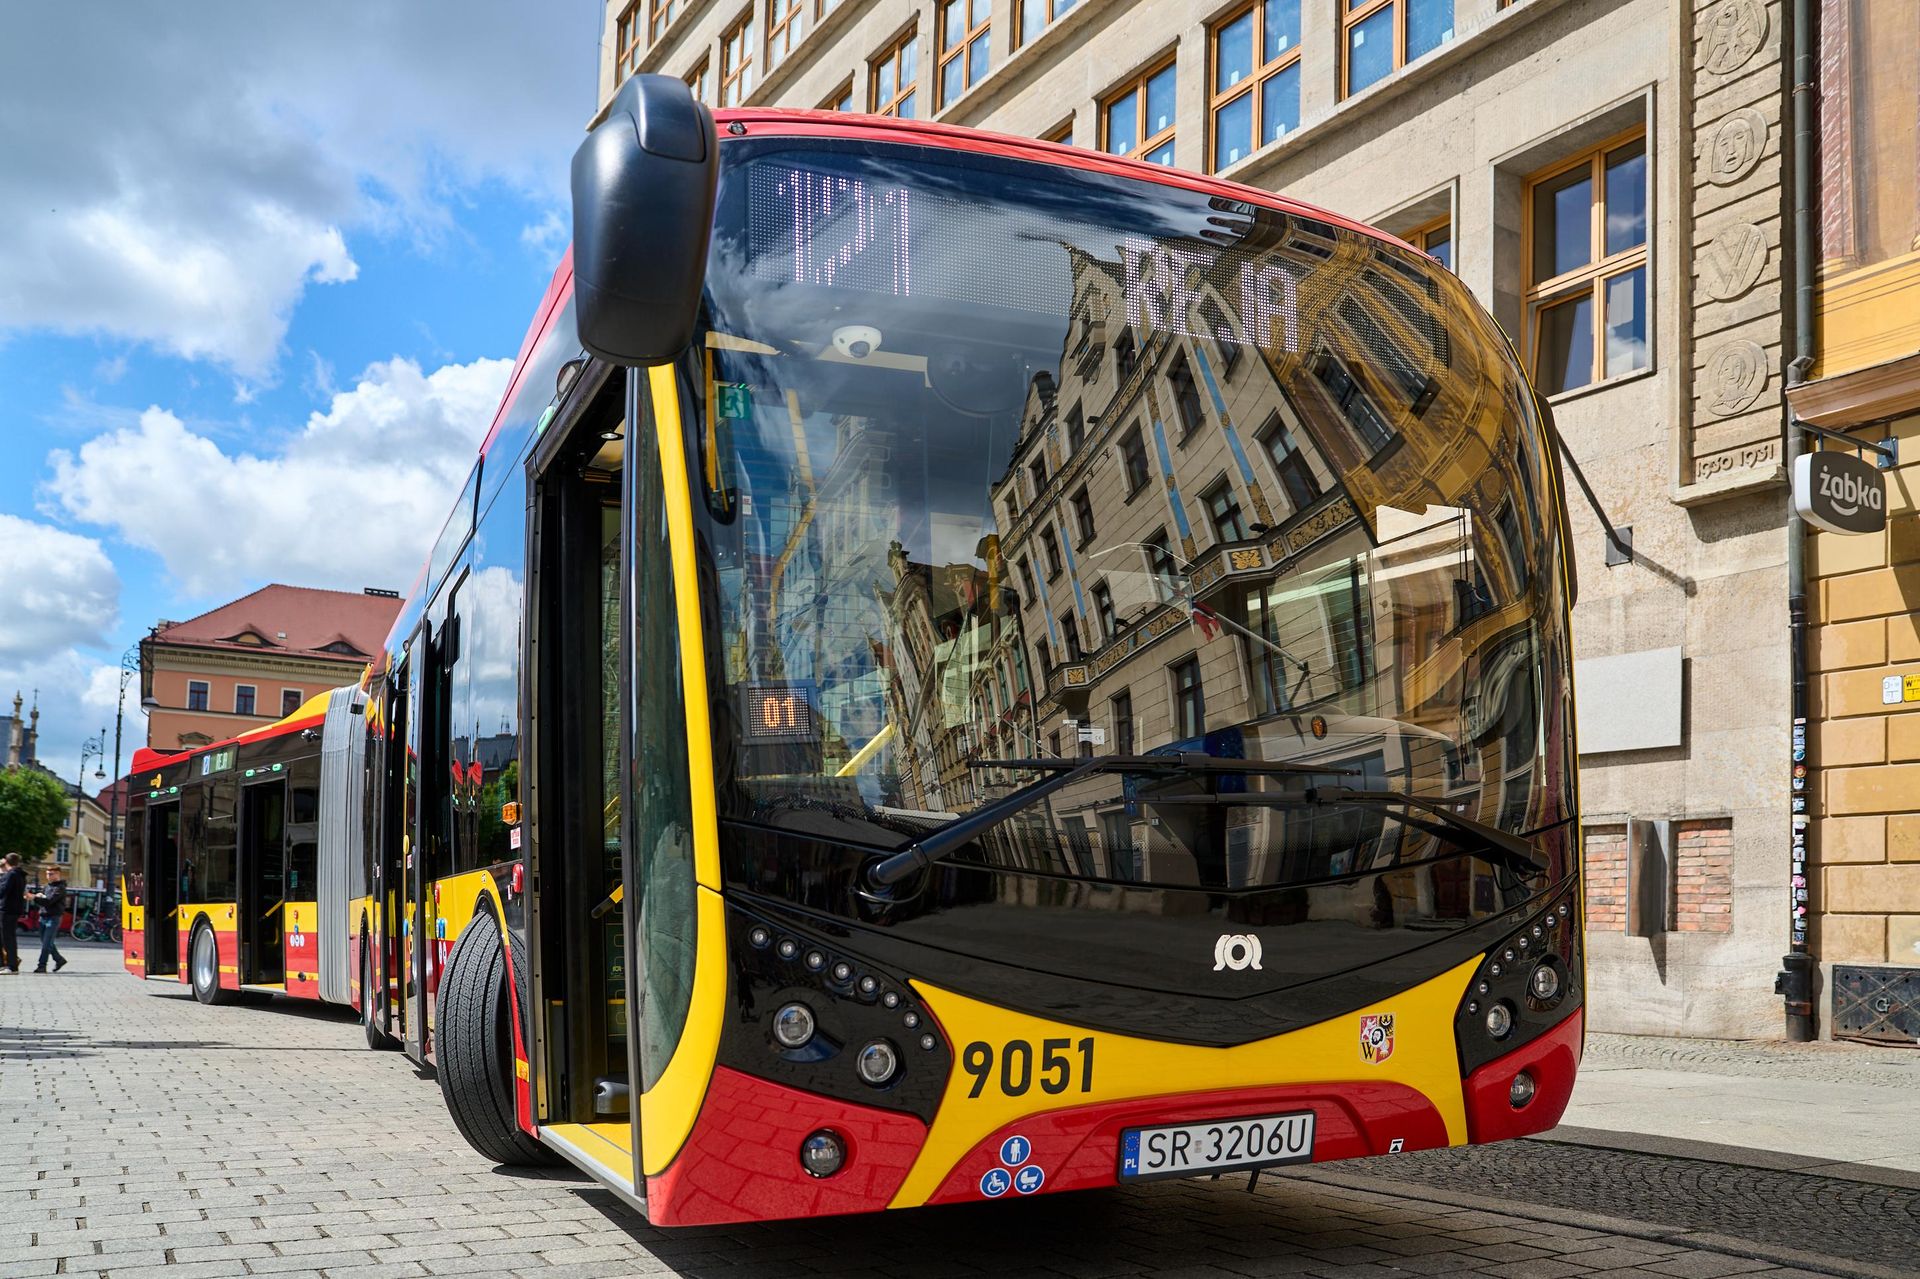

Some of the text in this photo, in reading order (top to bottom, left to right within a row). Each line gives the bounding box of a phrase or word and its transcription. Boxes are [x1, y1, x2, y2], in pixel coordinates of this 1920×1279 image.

[1125, 237, 1298, 352] REJA
[1819, 465, 1882, 510] żabka
[763, 697, 796, 727] 01
[1875, 997, 1890, 1012] G
[962, 1037, 1095, 1099] 9051
[1125, 1158, 1137, 1169] PL
[1147, 1118, 1307, 1169] SR 3206U
